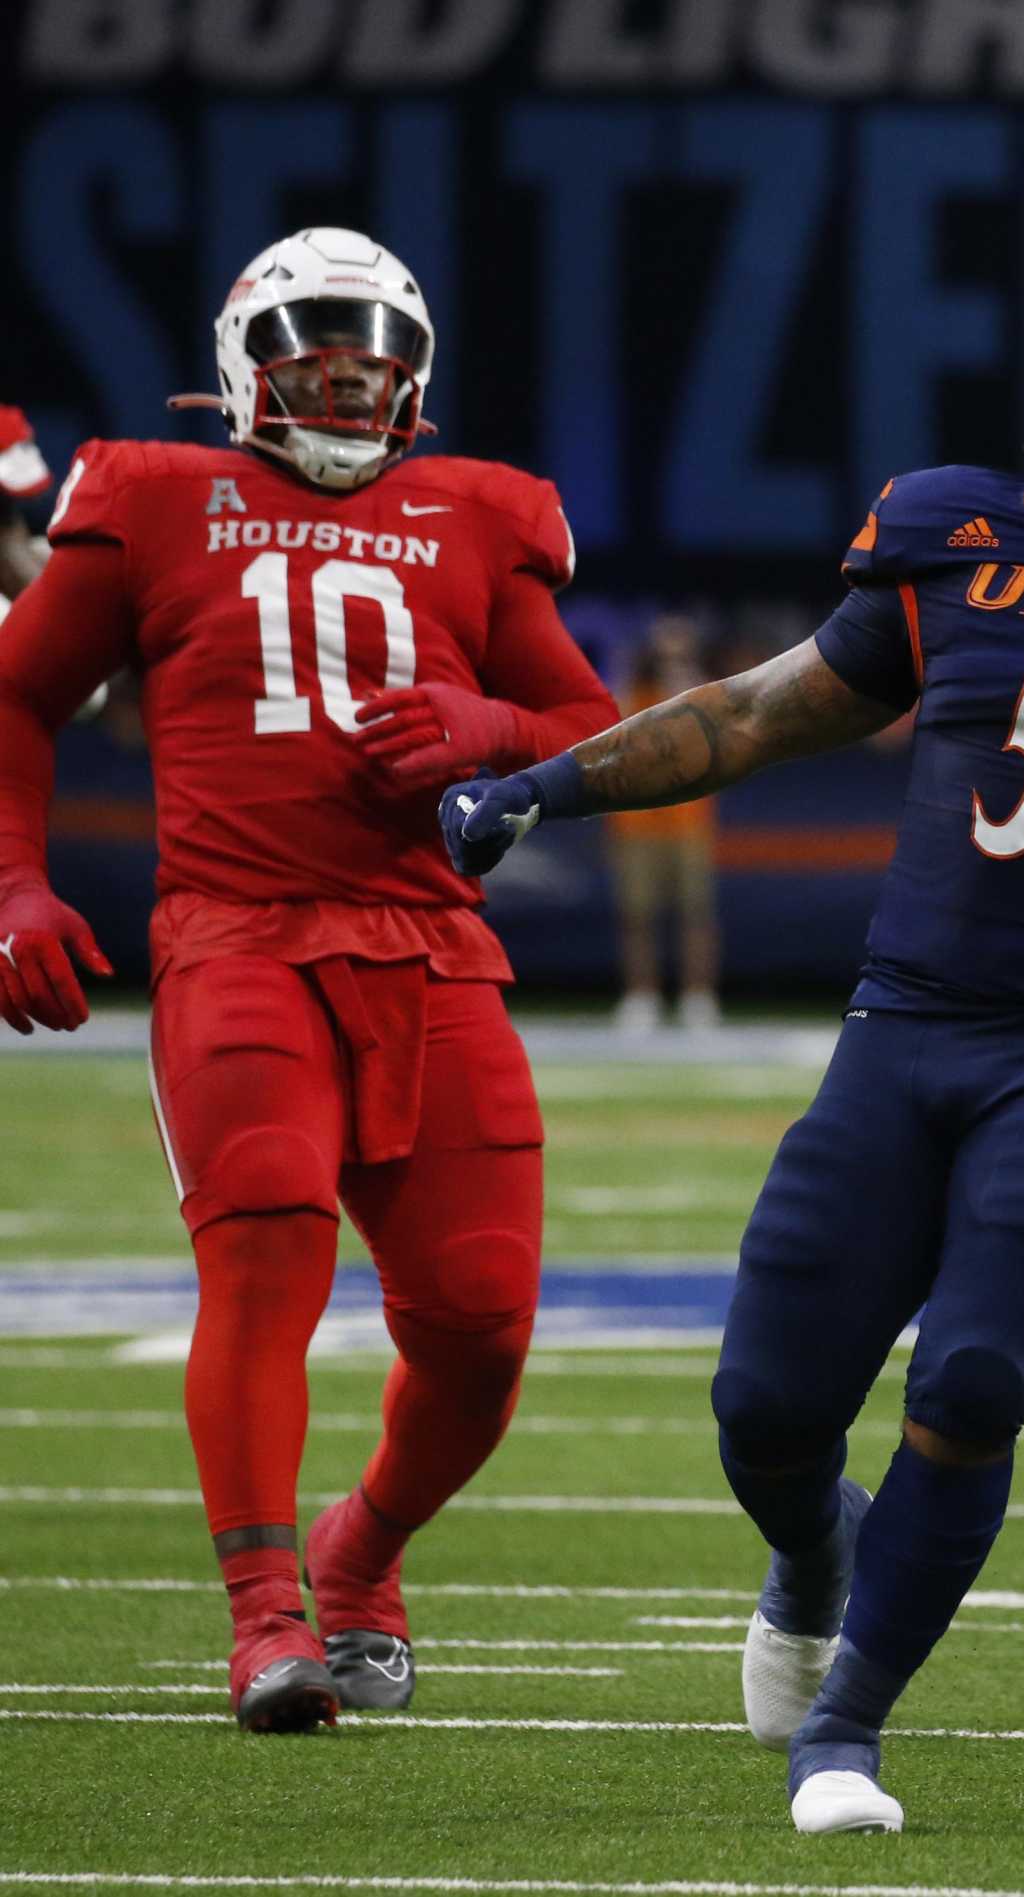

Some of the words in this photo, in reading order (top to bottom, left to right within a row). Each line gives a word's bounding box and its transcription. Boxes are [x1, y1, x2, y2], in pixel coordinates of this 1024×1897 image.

[206, 519, 441, 567] HOUSTON
[946, 533, 1000, 548] adidas
[241, 551, 417, 735] 10
